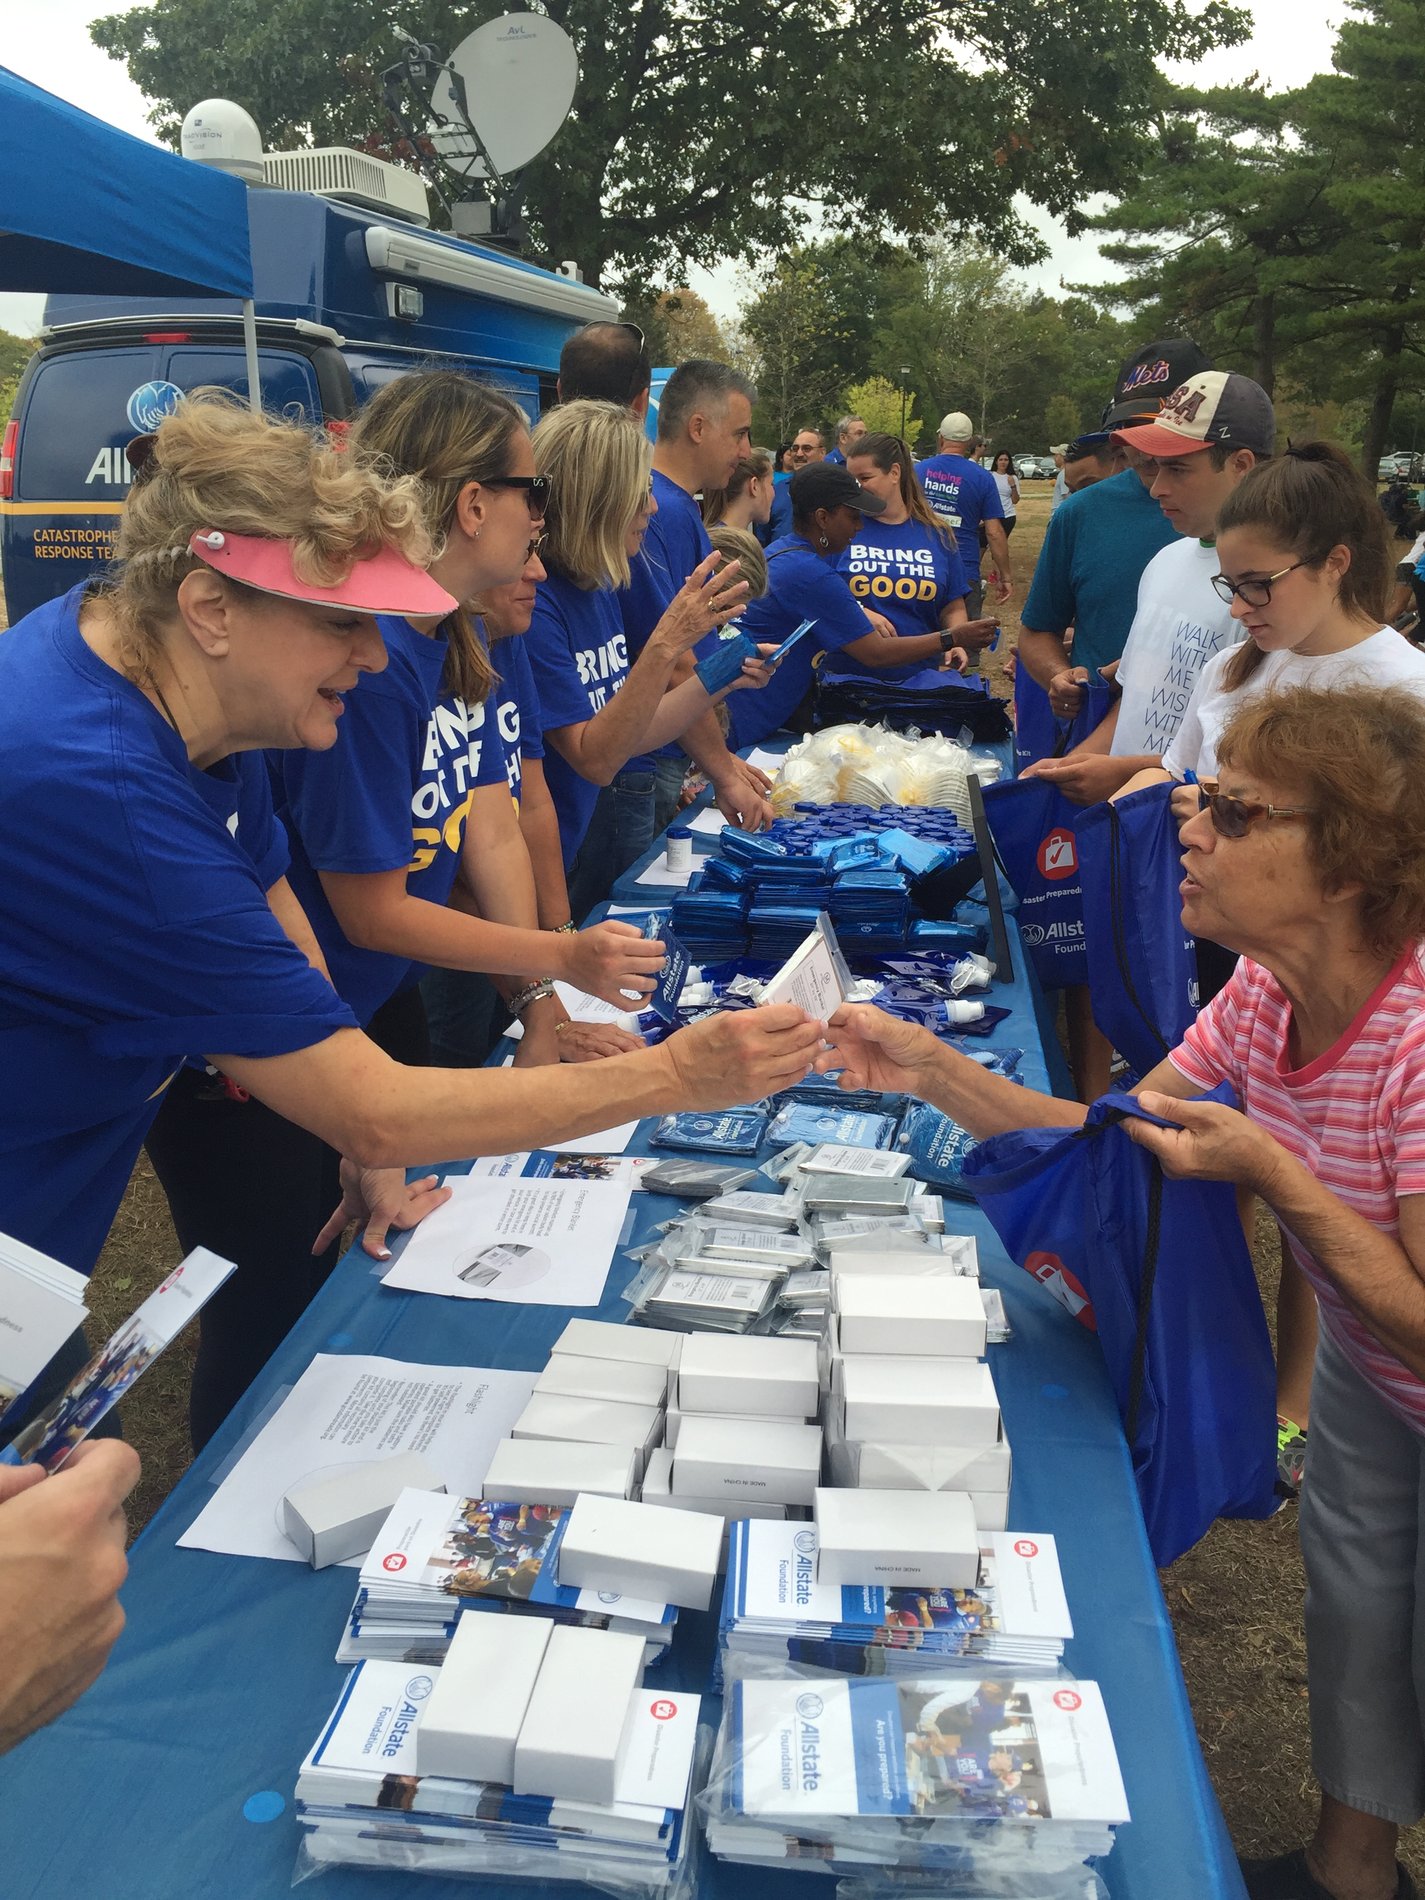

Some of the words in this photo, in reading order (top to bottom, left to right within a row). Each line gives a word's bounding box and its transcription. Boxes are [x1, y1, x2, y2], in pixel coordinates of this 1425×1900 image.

[1122, 360, 1170, 393] Mets
[1164, 385, 1207, 423] SA
[924, 477, 960, 495] hands
[926, 468, 962, 485] helping
[33, 528, 120, 543] CATASTROPHE
[35, 545, 94, 559] RESPONSE
[850, 544, 933, 564] BRING
[848, 561, 890, 574] OUT
[896, 563, 935, 578] THE
[849, 575, 937, 602] GOOD
[1176, 620, 1224, 652] WALK
[1164, 665, 1194, 690] ME
[1152, 686, 1193, 713] WIS
[1145, 708, 1183, 734] WIT
[1046, 886, 1083, 899] Prepared
[1045, 920, 1084, 940] Allst
[1055, 941, 1087, 954] Found
[663, 951, 682, 1002] Allstate
[712, 1117, 732, 1140] Allstate
[836, 1114, 856, 1142] Allstate
[465, 1384, 489, 1415] Flashlight
[724, 1478, 741, 1486] CHINA
[778, 1559, 789, 1604] Foundation
[796, 1554, 813, 1606] Allstate
[875, 1565, 894, 1573] CHINA
[362, 1706, 392, 1755] Foundation
[382, 1701, 418, 1757] Allstate
[875, 1719, 886, 1734] Are
[801, 1721, 822, 1792] Allstate
[875, 1735, 887, 1753] you
[780, 1729, 792, 1791] Foundation
[877, 1752, 894, 1801] prepared?
